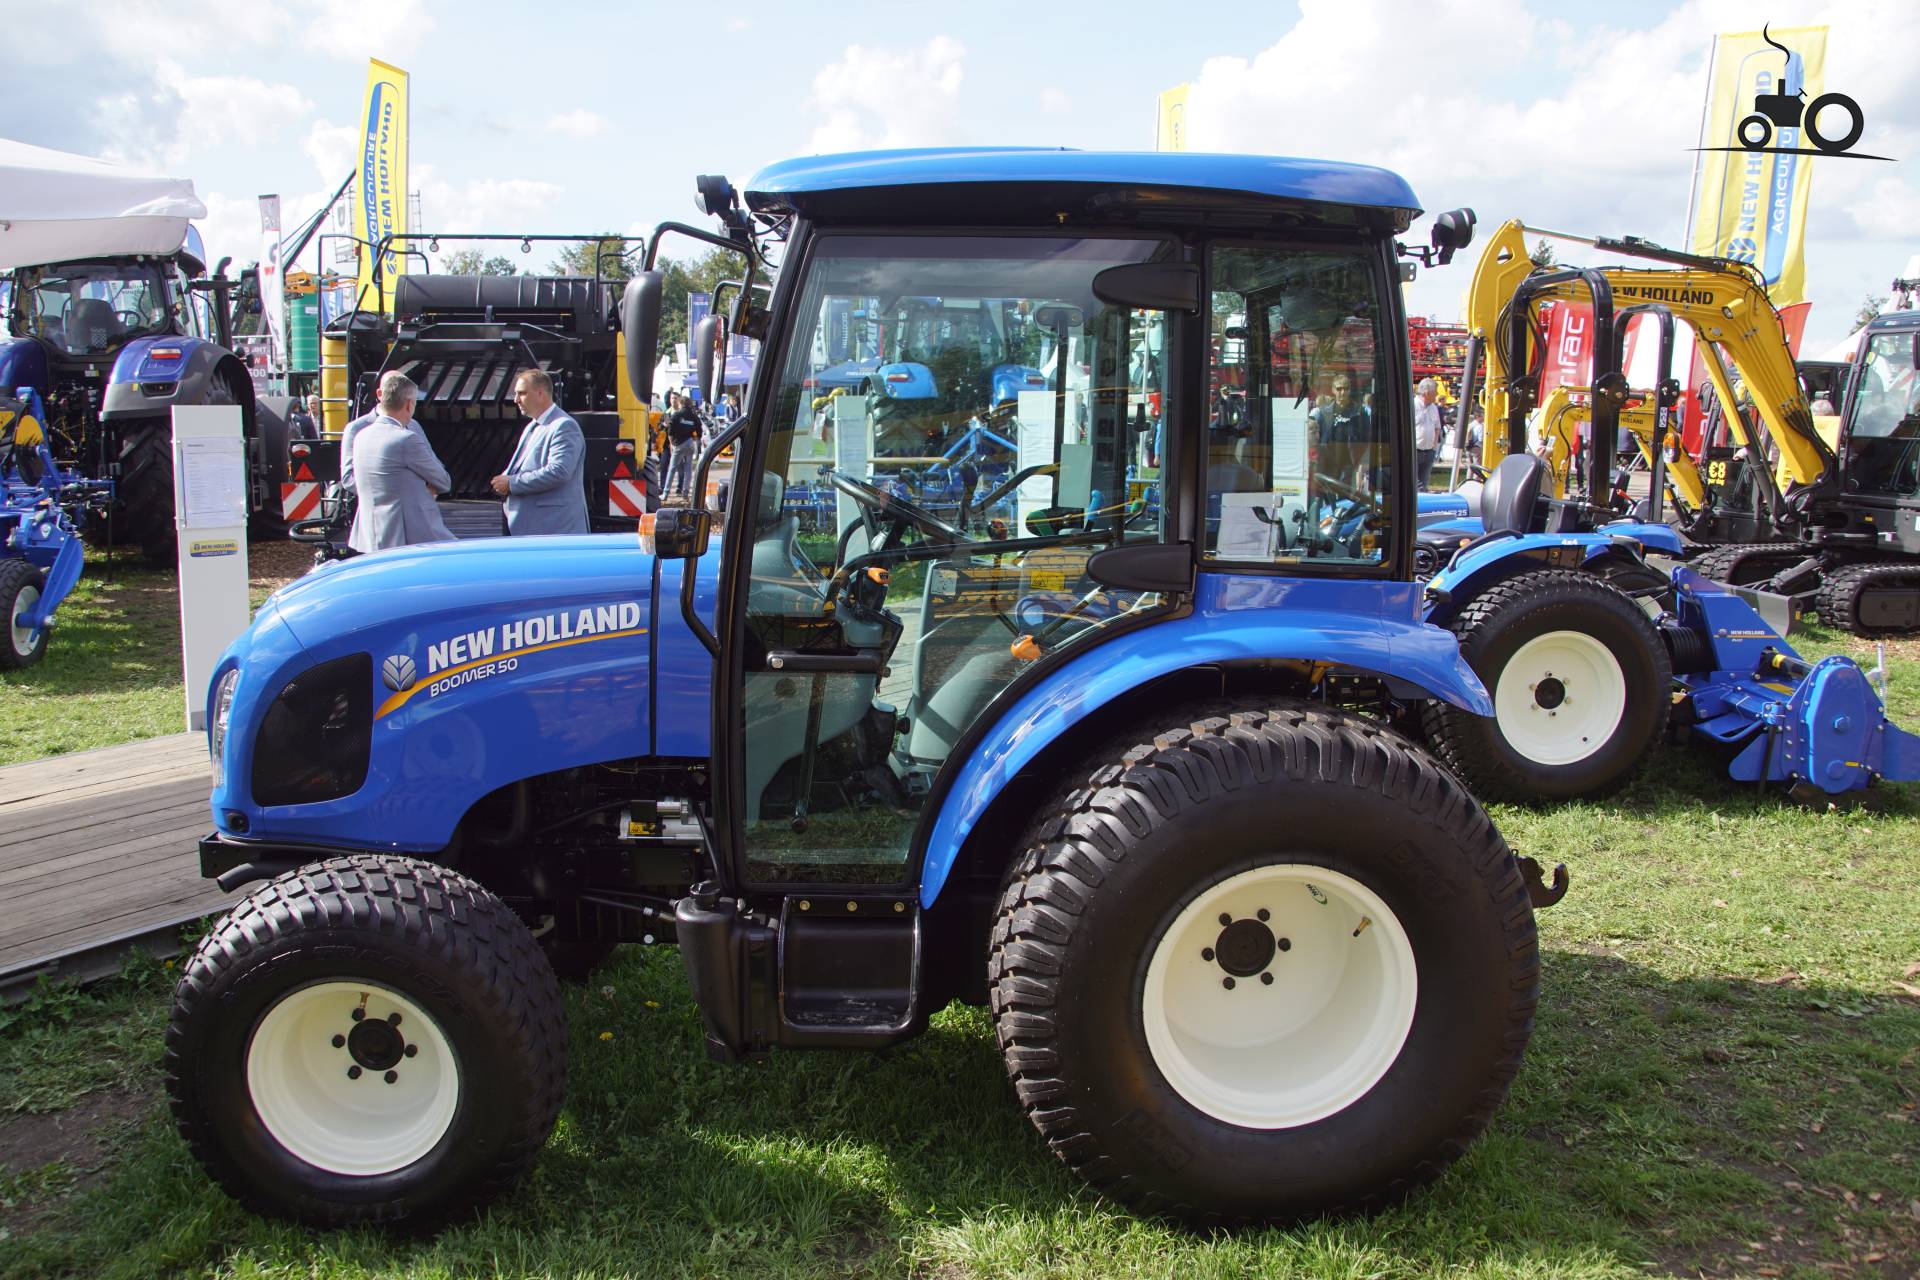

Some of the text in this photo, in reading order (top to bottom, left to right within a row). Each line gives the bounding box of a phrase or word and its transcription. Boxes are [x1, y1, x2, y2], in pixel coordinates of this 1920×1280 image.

[1739, 181, 1759, 231] NEW
[1612, 287, 1714, 305] EW HOLLAND
[1558, 308, 1585, 387] rifac
[1708, 461, 1727, 479] €8
[428, 602, 640, 673] NEW HOLLAND
[430, 658, 518, 697] BOOMER 50
